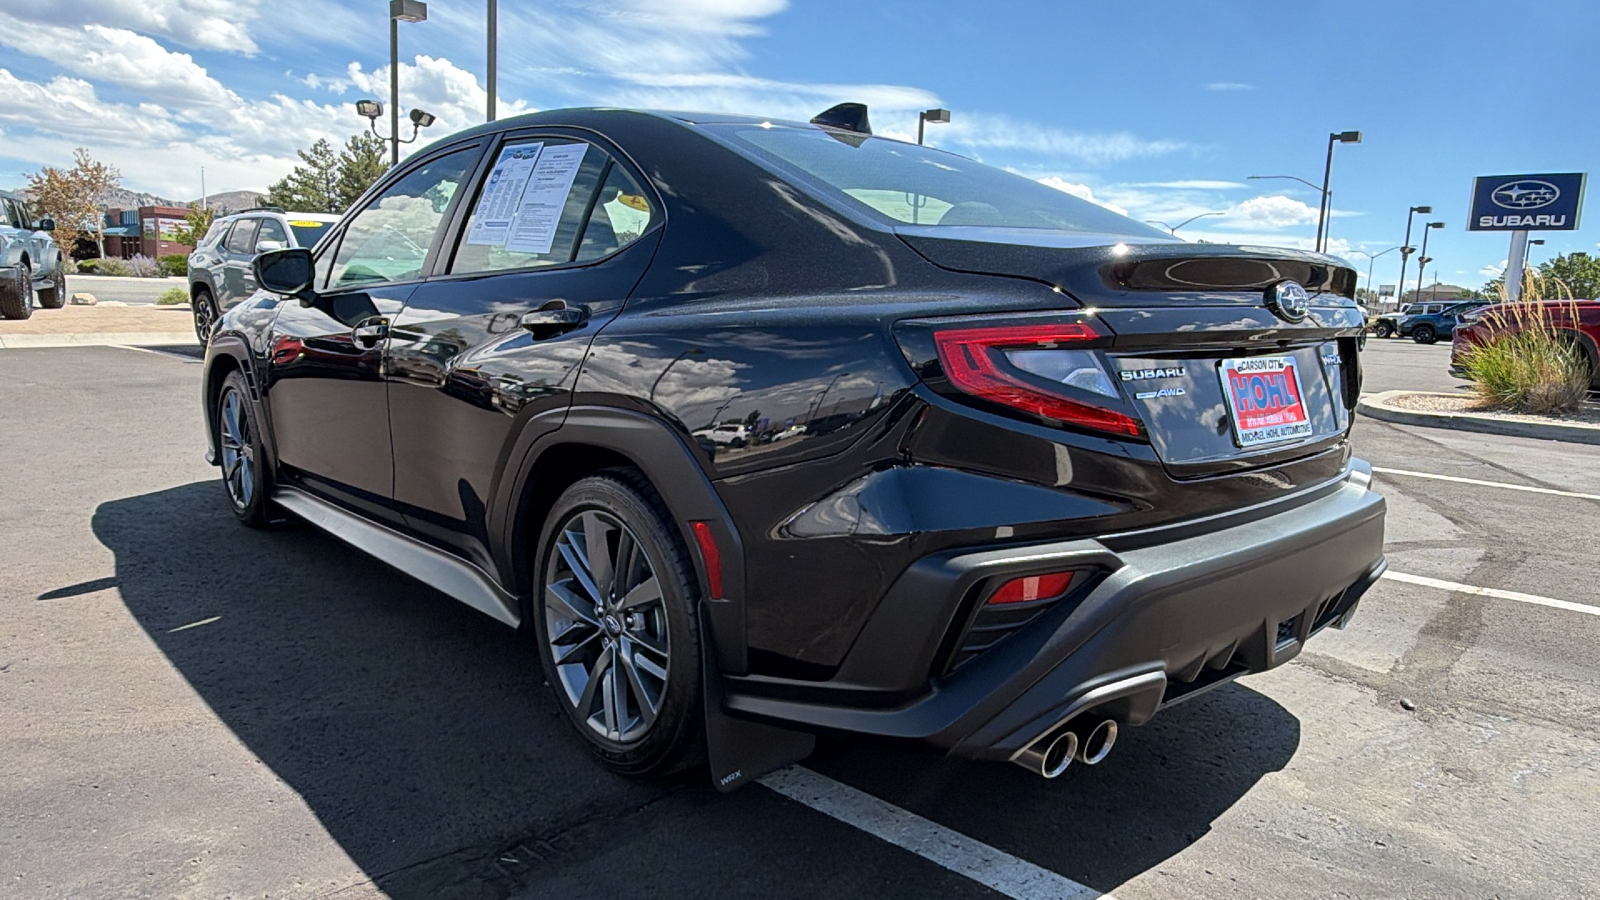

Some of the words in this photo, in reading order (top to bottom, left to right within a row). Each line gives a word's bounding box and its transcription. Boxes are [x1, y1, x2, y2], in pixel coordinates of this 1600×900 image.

[1479, 214, 1566, 227] SUBARU
[1241, 359, 1267, 371] CARSON
[1268, 357, 1283, 369] CITY
[1321, 354, 1342, 366] WRX
[1120, 368, 1186, 381] SUBARU
[1156, 387, 1186, 398] AWD
[1233, 374, 1297, 411] HOHL
[1241, 430, 1266, 443] MICHAEL
[1266, 428, 1280, 439] HOHL
[1280, 423, 1311, 436] AUTOMOTIVE
[720, 769, 742, 785] WRX
